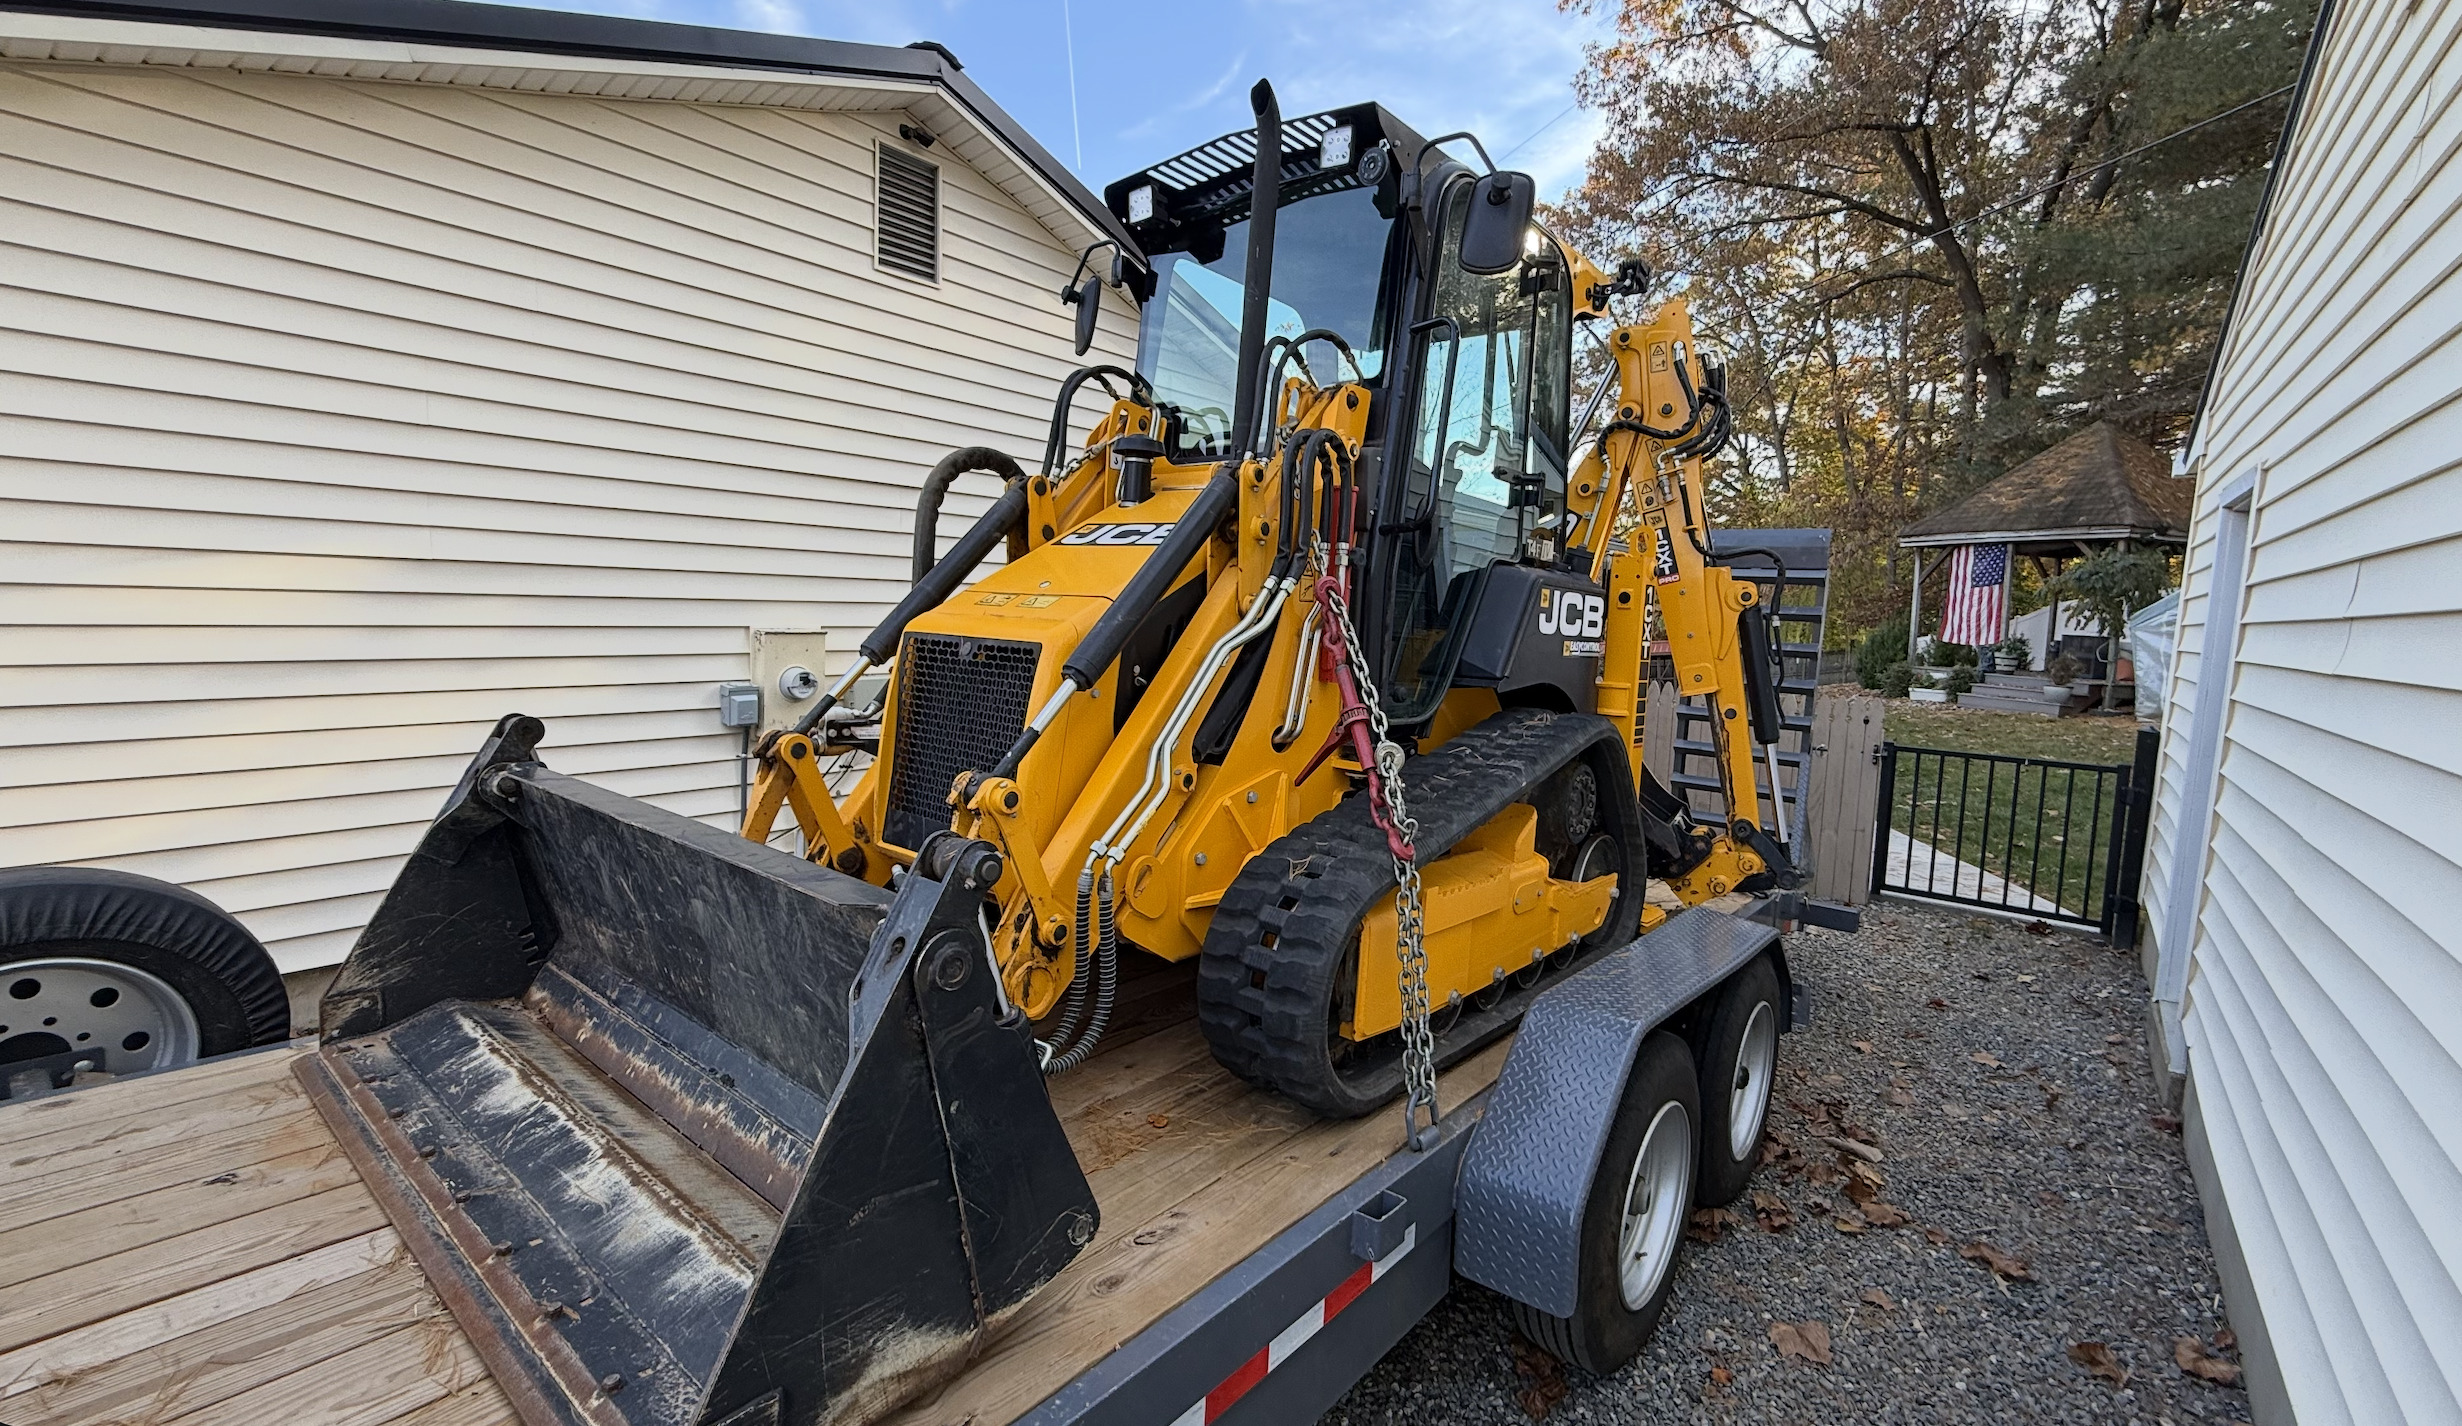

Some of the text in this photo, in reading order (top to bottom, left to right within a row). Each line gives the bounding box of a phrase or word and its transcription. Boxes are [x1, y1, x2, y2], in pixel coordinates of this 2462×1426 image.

[1655, 528, 1673, 576] 1CXT
[1658, 574, 1680, 585] PRO
[1538, 589, 1605, 638] JCB
[1641, 586, 1654, 659] 1CXT
